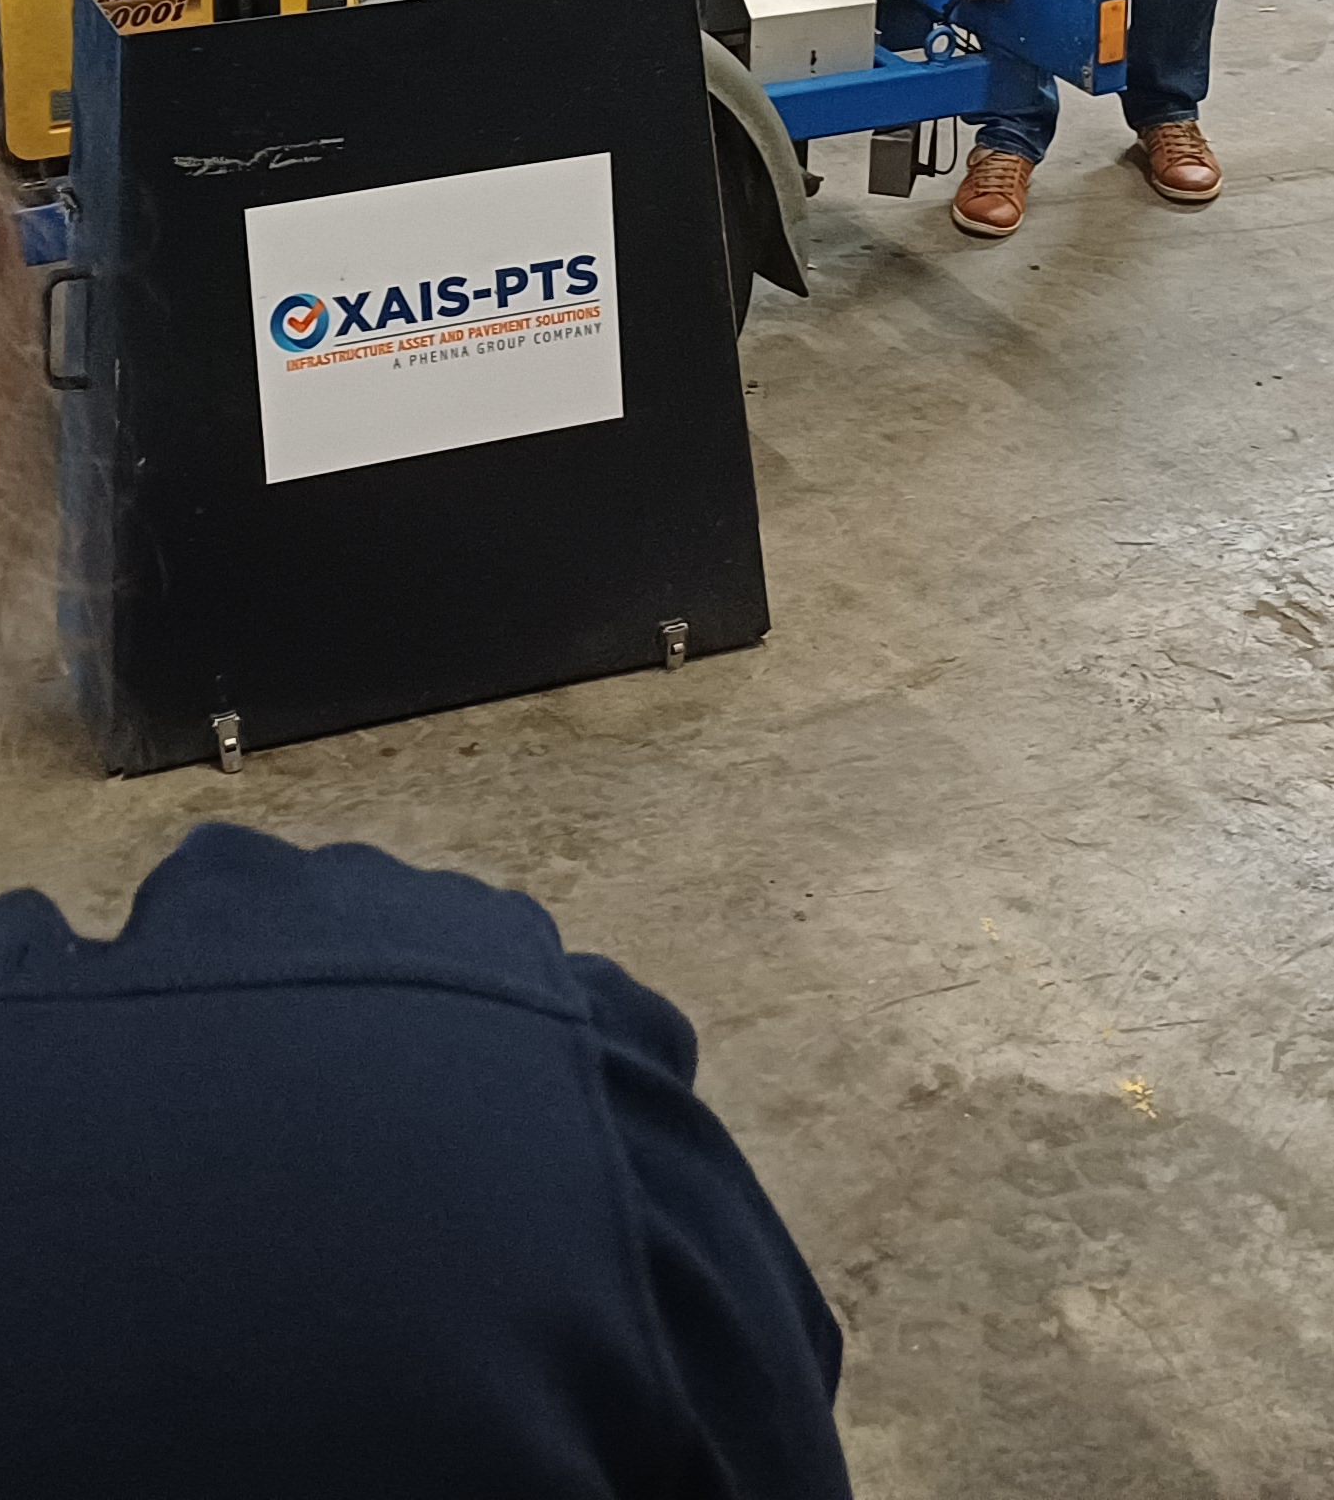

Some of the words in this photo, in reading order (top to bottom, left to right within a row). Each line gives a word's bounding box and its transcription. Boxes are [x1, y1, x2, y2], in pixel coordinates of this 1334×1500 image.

[332, 254, 599, 338] XAIS-PTS
[285, 341, 394, 373] INFRASTRUCTURE
[397, 333, 436, 352] ASSET
[439, 329, 465, 345] AND
[467, 317, 532, 340] PAVEMENT
[535, 305, 602, 328] SOLUTIONS
[392, 357, 402, 370] A
[409, 345, 471, 368] PHENNA
[476, 335, 526, 356] GROUP
[533, 322, 602, 346] COMPANY
